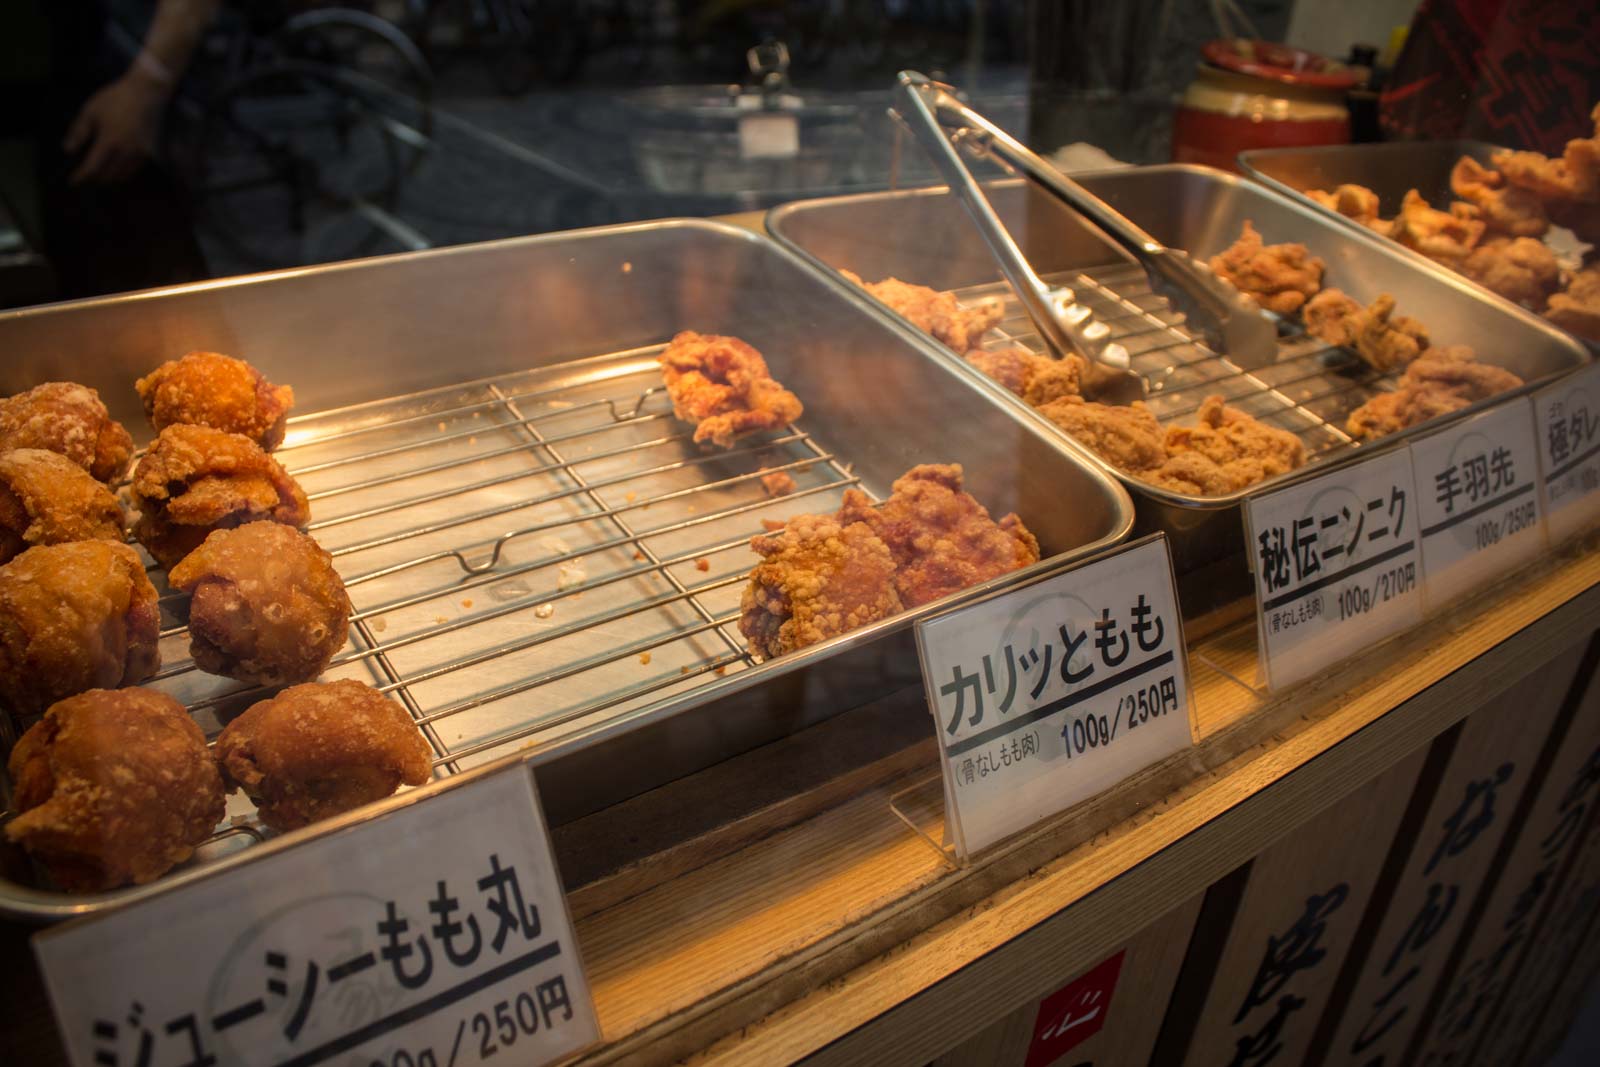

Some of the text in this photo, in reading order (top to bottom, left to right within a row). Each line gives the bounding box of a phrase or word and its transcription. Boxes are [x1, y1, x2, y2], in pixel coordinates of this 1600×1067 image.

[1435, 447, 1515, 513] 手羽先
[1258, 486, 1406, 593] 秘伝ニンニク
[1338, 561, 1415, 621] 100g/270円
[940, 595, 1164, 736] カリッともも
[1061, 675, 1178, 759] 100g/250円
